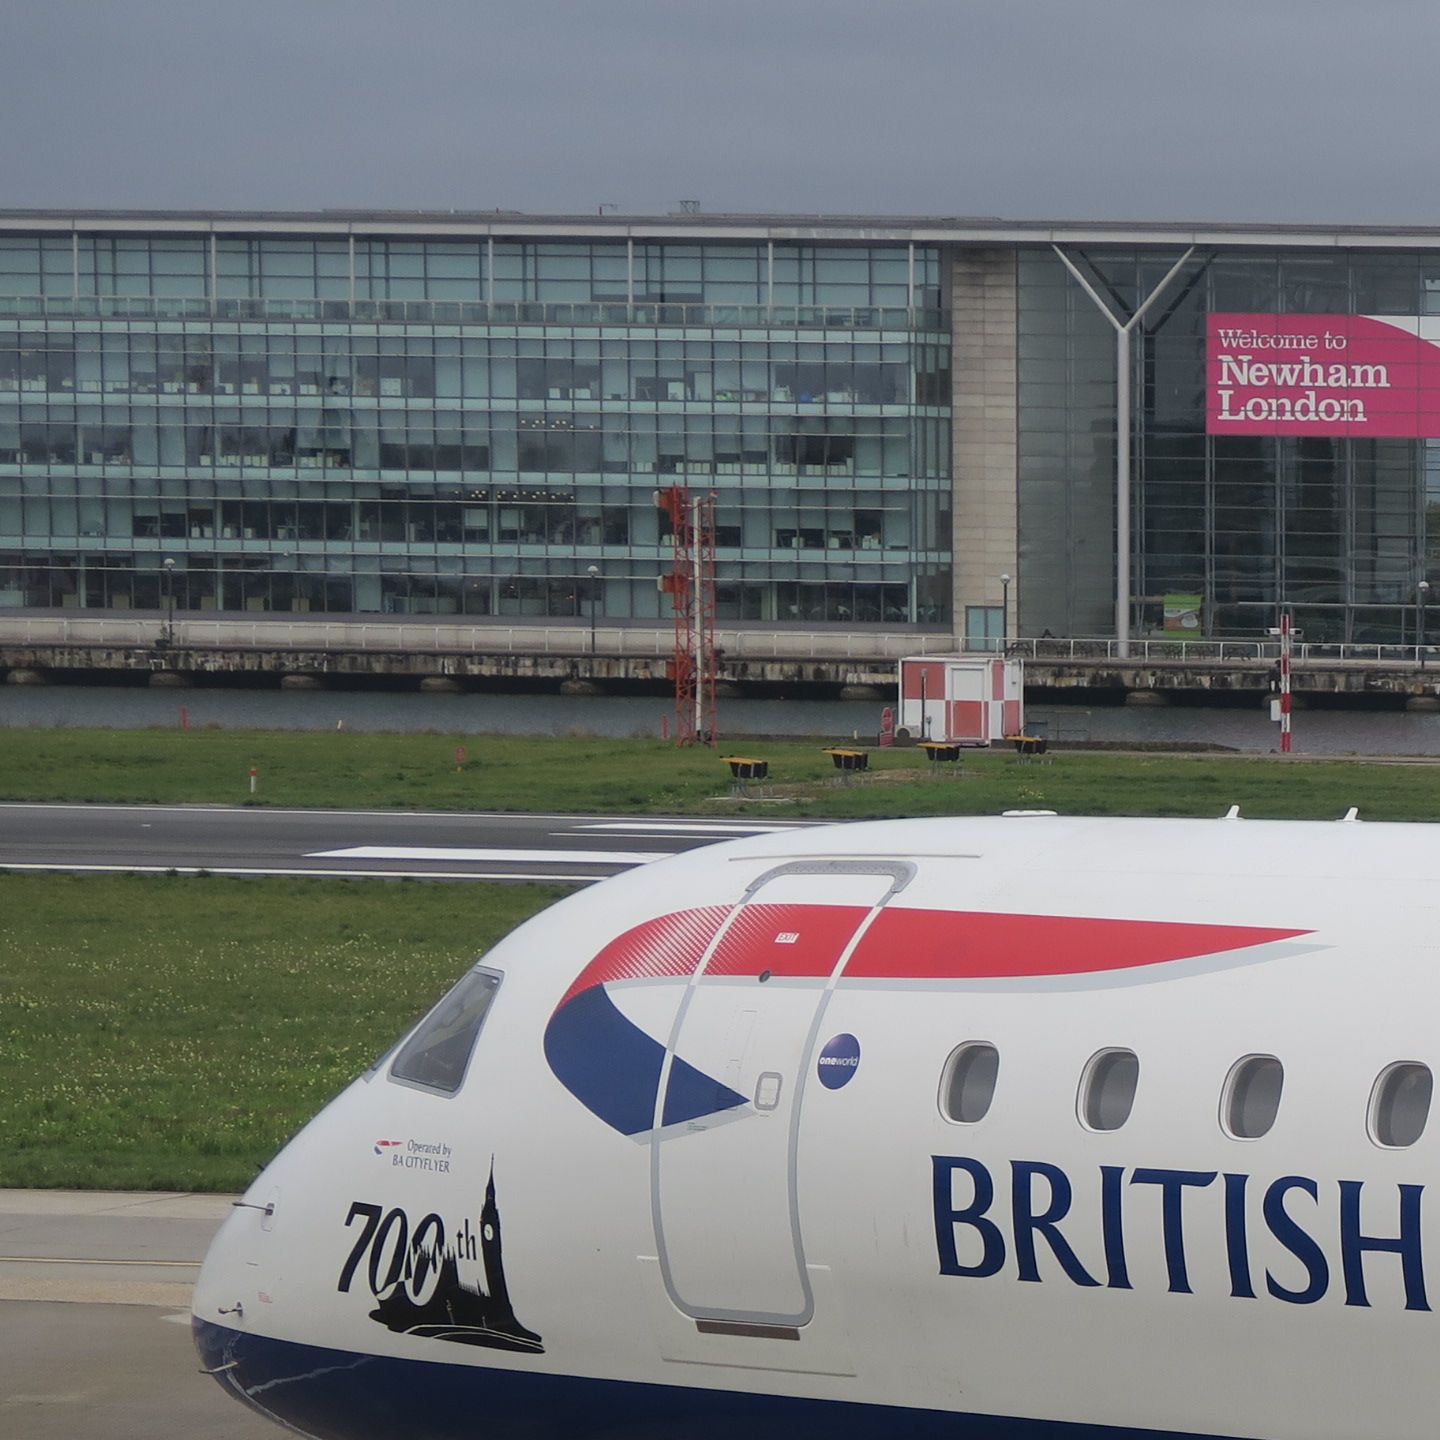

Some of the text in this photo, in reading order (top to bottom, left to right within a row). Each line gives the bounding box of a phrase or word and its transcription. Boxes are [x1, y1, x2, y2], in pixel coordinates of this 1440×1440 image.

[1217, 329, 1347, 350] Welcome to
[1217, 355, 1391, 387] Newham
[1217, 390, 1367, 422] London
[407, 1139, 452, 1158] Operated by
[392, 1154, 450, 1174] BA CITYFLYER
[934, 1155, 1429, 1310] BRITISH
